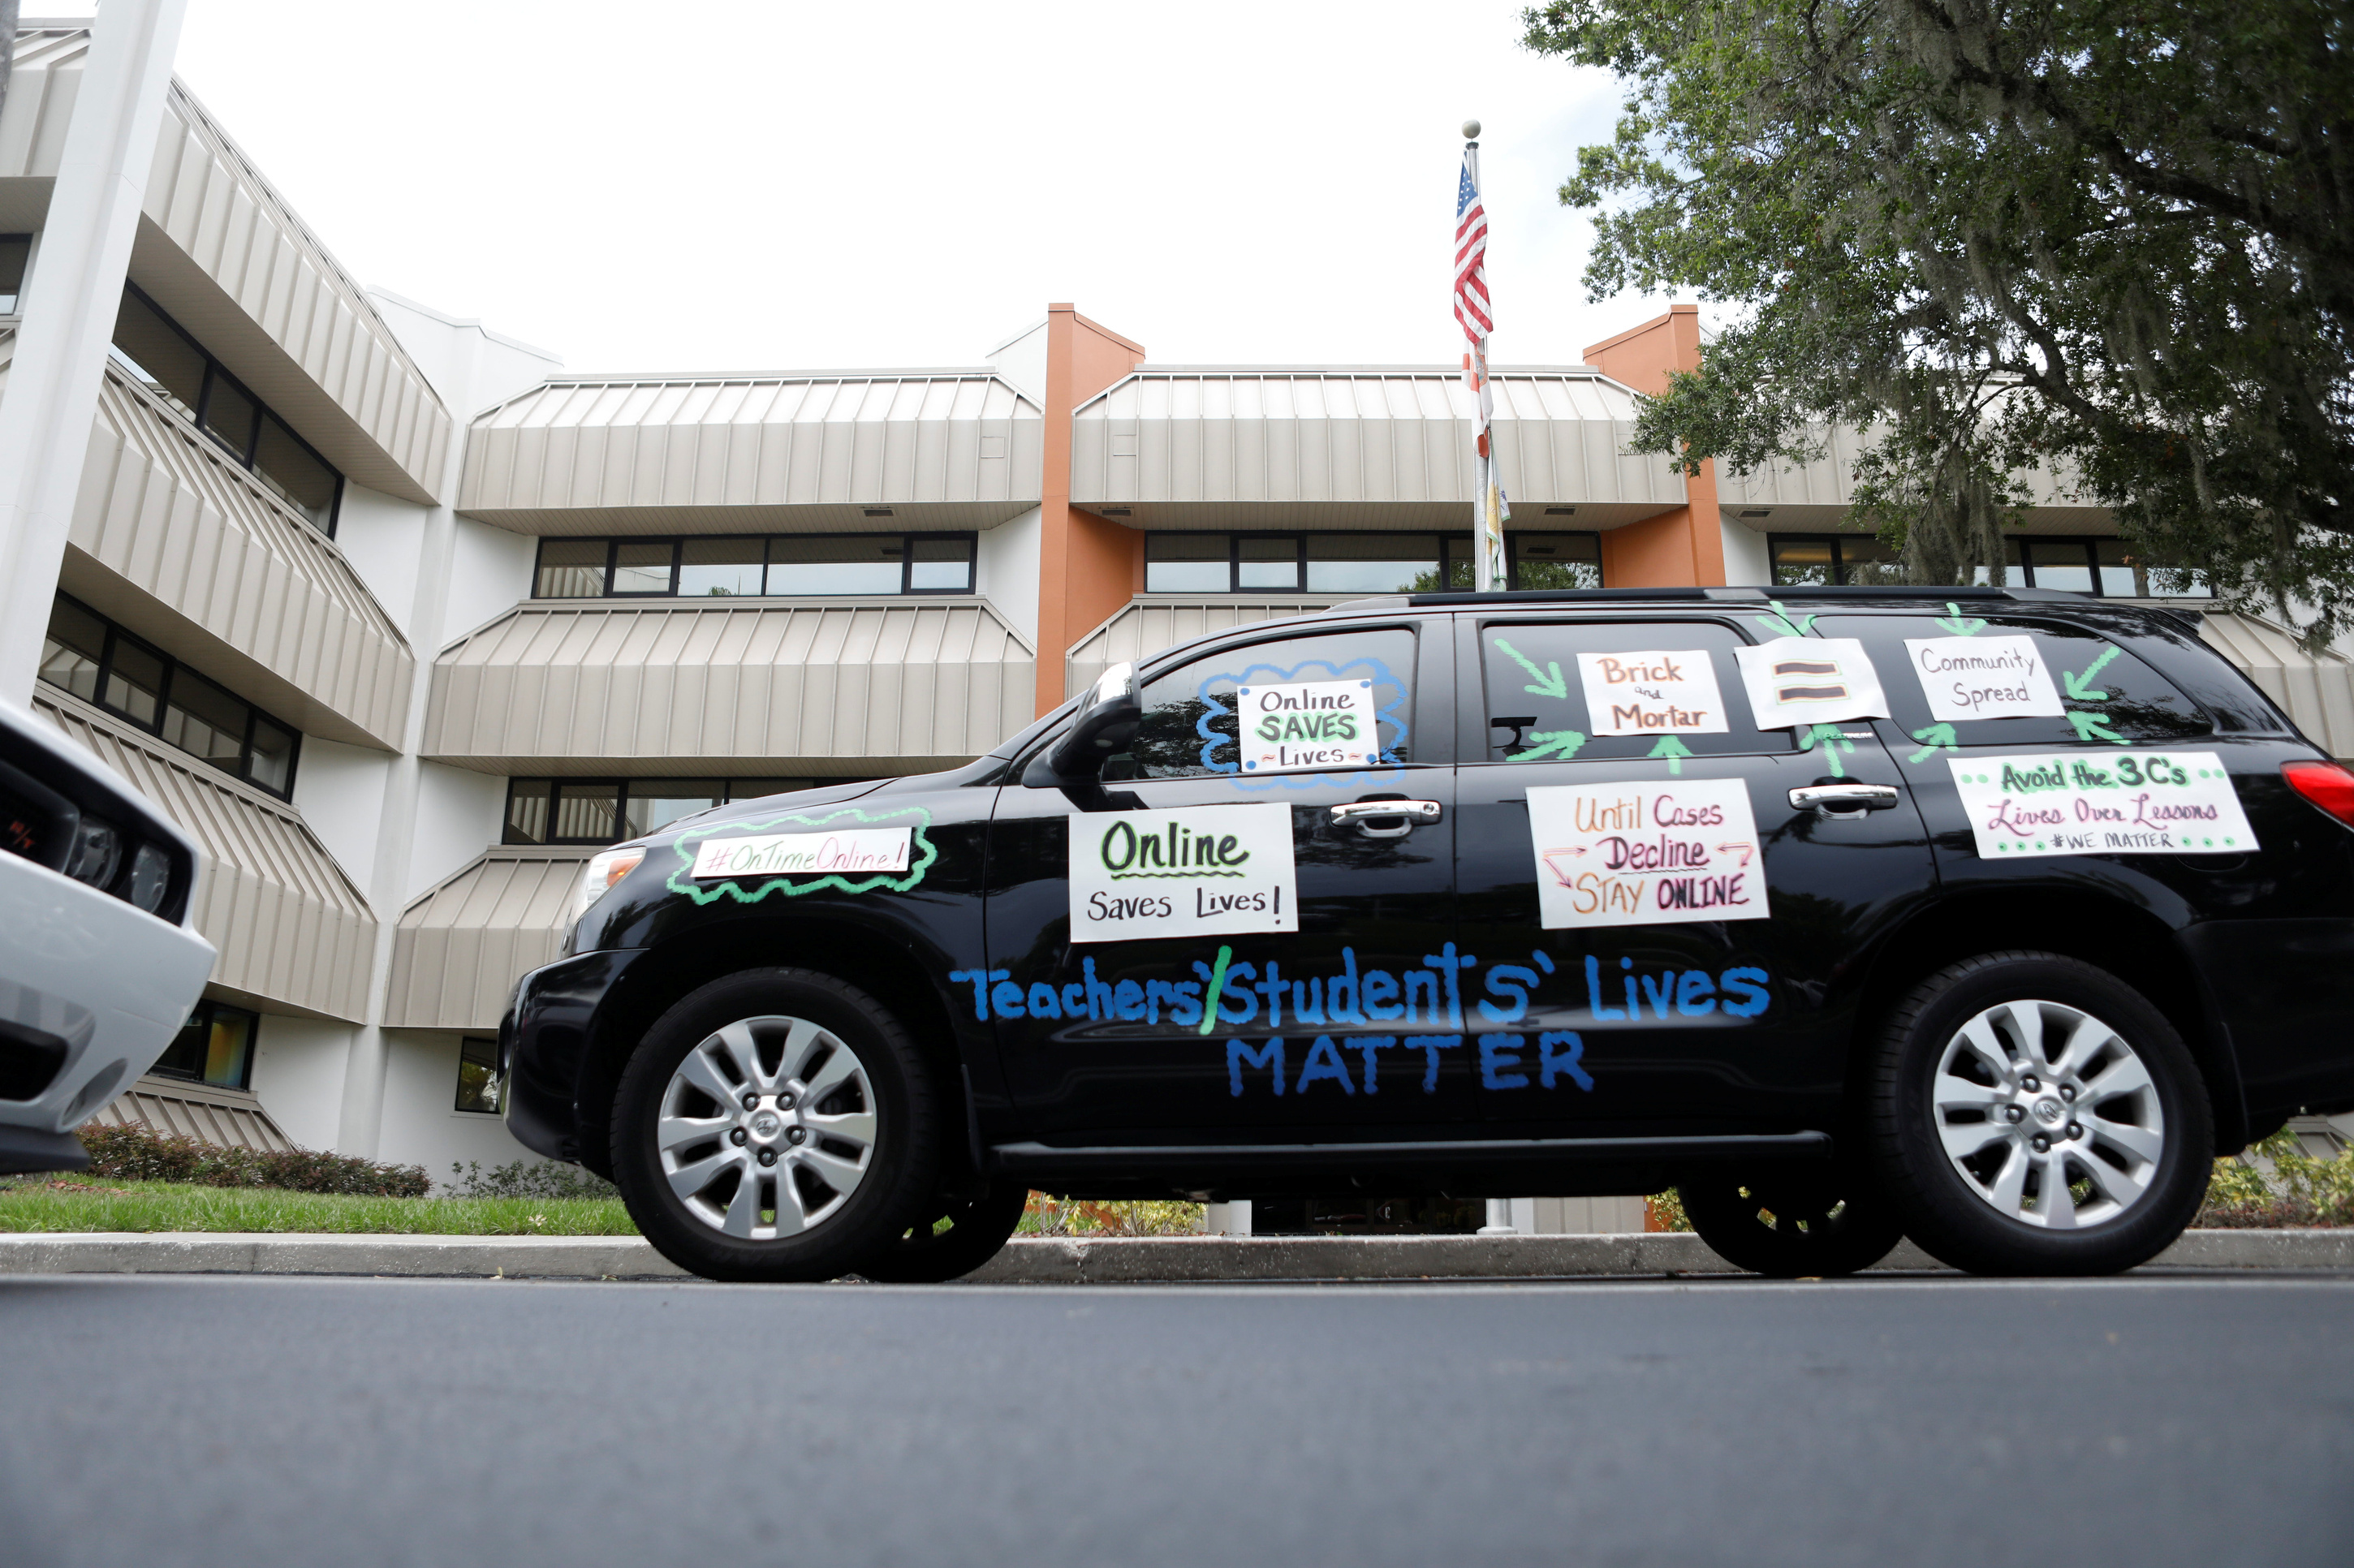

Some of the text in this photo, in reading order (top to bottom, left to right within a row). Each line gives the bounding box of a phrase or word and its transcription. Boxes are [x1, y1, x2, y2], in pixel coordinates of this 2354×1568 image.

[1596, 656, 1684, 684] Brick
[1921, 647, 2035, 677] Community
[1260, 688, 1355, 712] Online
[1635, 686, 1664, 700] and
[1951, 678, 2031, 712] Spread
[1257, 713, 1358, 742] SAVES
[1611, 704, 1707, 730] Mortar
[2002, 764, 2065, 790] Avoid
[2072, 763, 2112, 786] the
[1575, 795, 1723, 833] Until Cases
[1987, 793, 2218, 837] Lives Over Lessons
[706, 837, 905, 872] #OnTimeOnline!
[1101, 821, 1250, 871] Online
[1595, 834, 1710, 870] Decline
[2105, 833, 2175, 849] MATTER
[1088, 885, 1280, 924] Saves Lives!
[1572, 872, 1750, 915] STAY ONLINE
[1585, 954, 1770, 1021] Lives
[1227, 1031, 1594, 1096] MATTER
